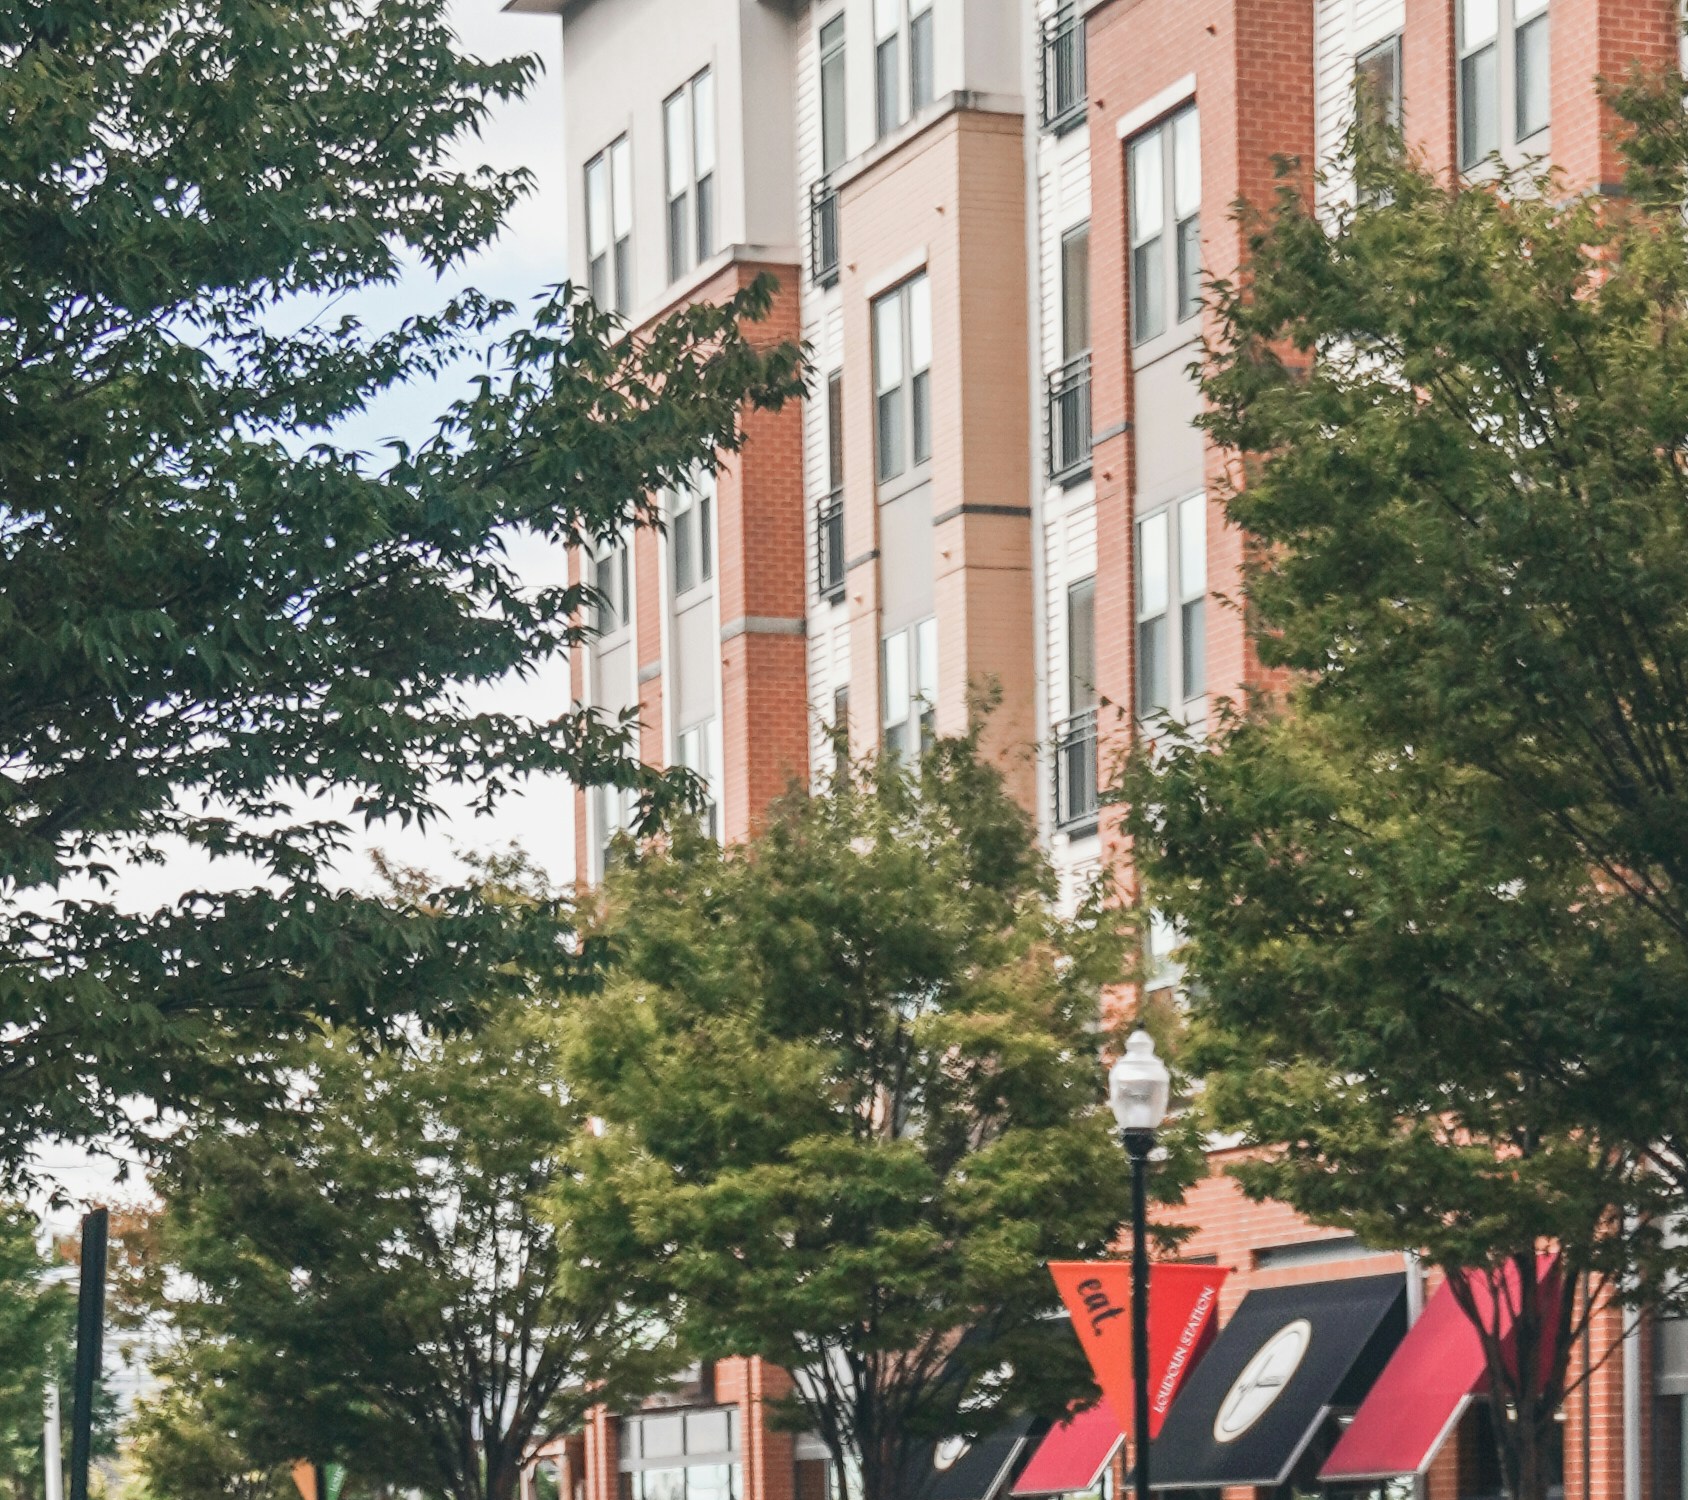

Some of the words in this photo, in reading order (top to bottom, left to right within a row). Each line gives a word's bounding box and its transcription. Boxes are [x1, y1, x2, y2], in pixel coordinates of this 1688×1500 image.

[1078, 1278, 1125, 1336] eat.
[1152, 1346, 1188, 1413] LOUDOUN
[1179, 1285, 1215, 1347] STATION
